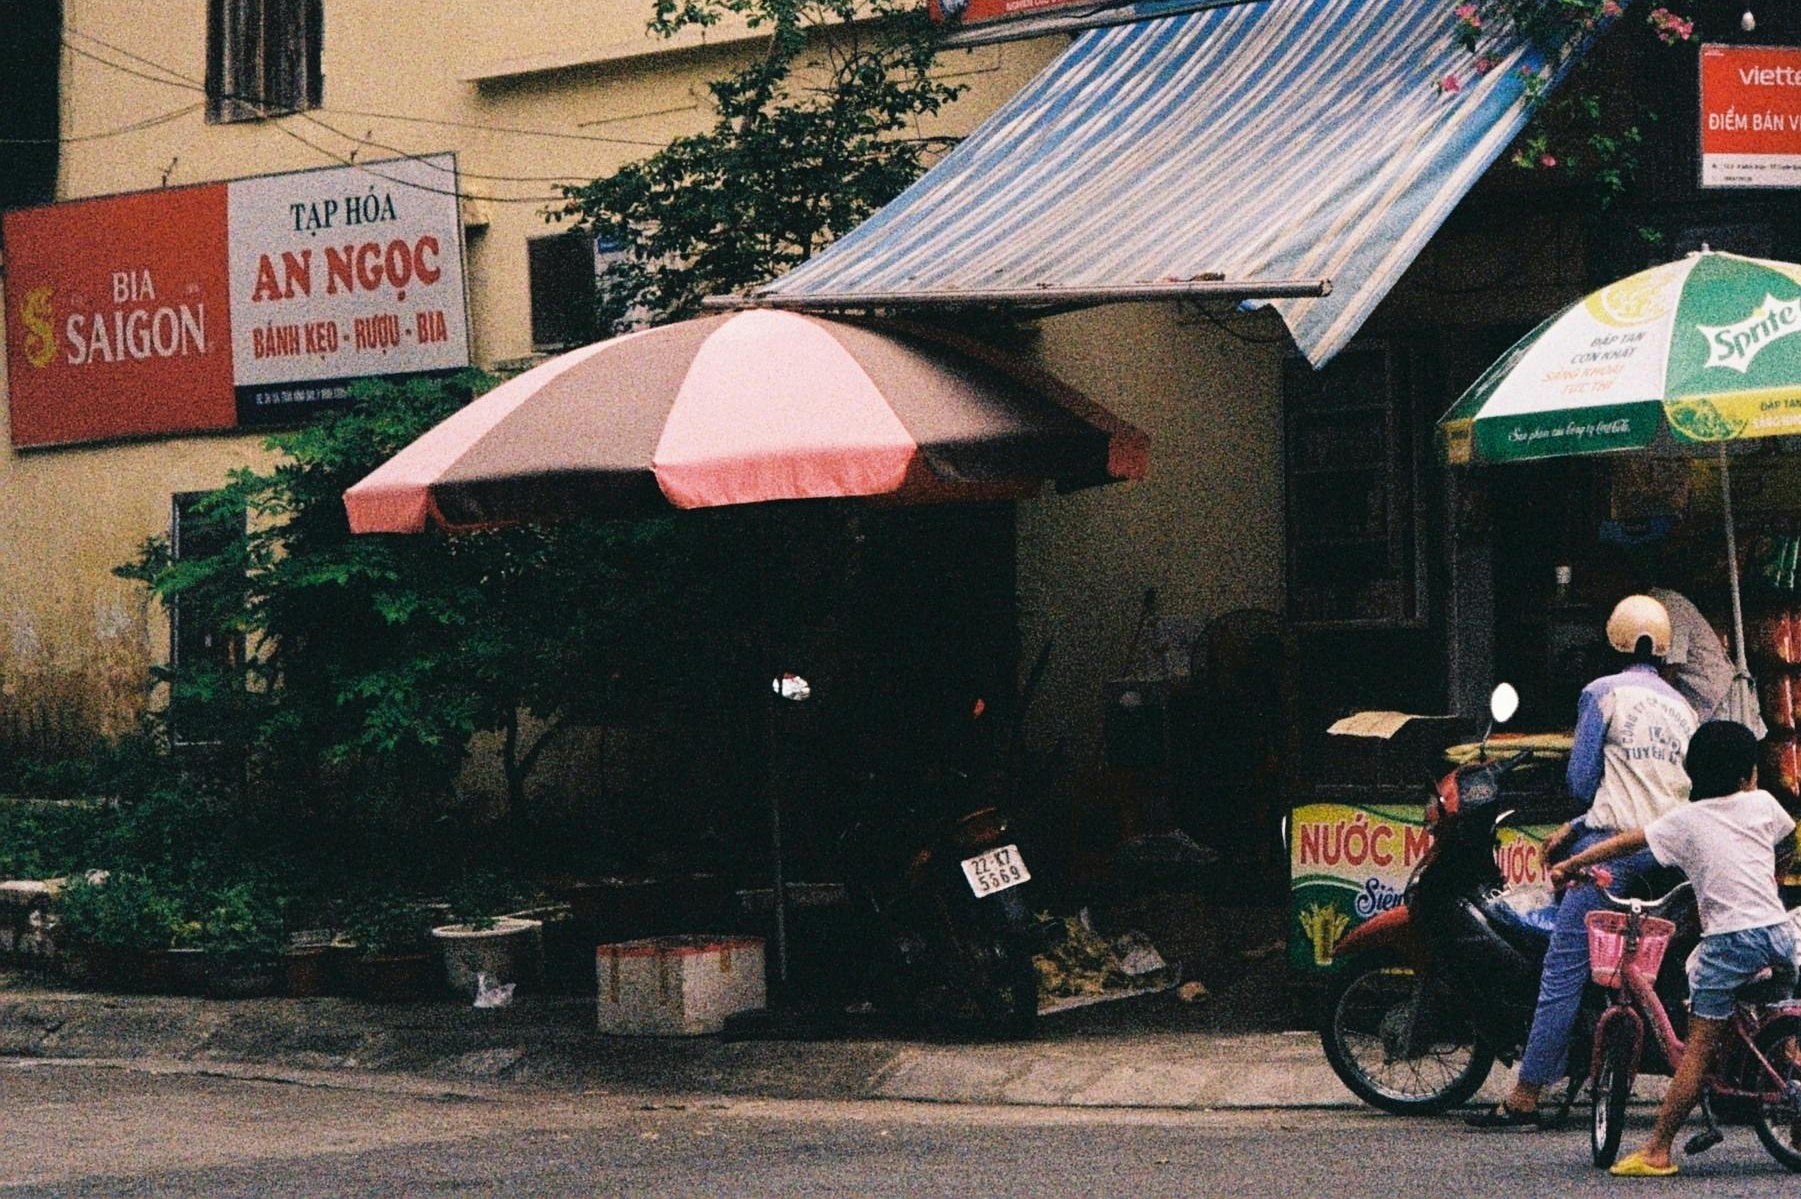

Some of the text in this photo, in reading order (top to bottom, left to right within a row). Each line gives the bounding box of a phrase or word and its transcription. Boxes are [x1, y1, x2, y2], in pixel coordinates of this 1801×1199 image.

[1708, 105, 1748, 131] ĐIỂM
[1752, 110, 1784, 131] BÁN
[291, 185, 398, 237] TẠP HÓA
[112, 269, 156, 303] BIA
[252, 234, 441, 302] AN NGỌC
[66, 302, 207, 365] SAIGON
[252, 310, 448, 362] BÁNH KẸO RƯỢU BIA
[1714, 305, 1799, 362] Sprite
[1300, 813, 1393, 866] NƯỚC
